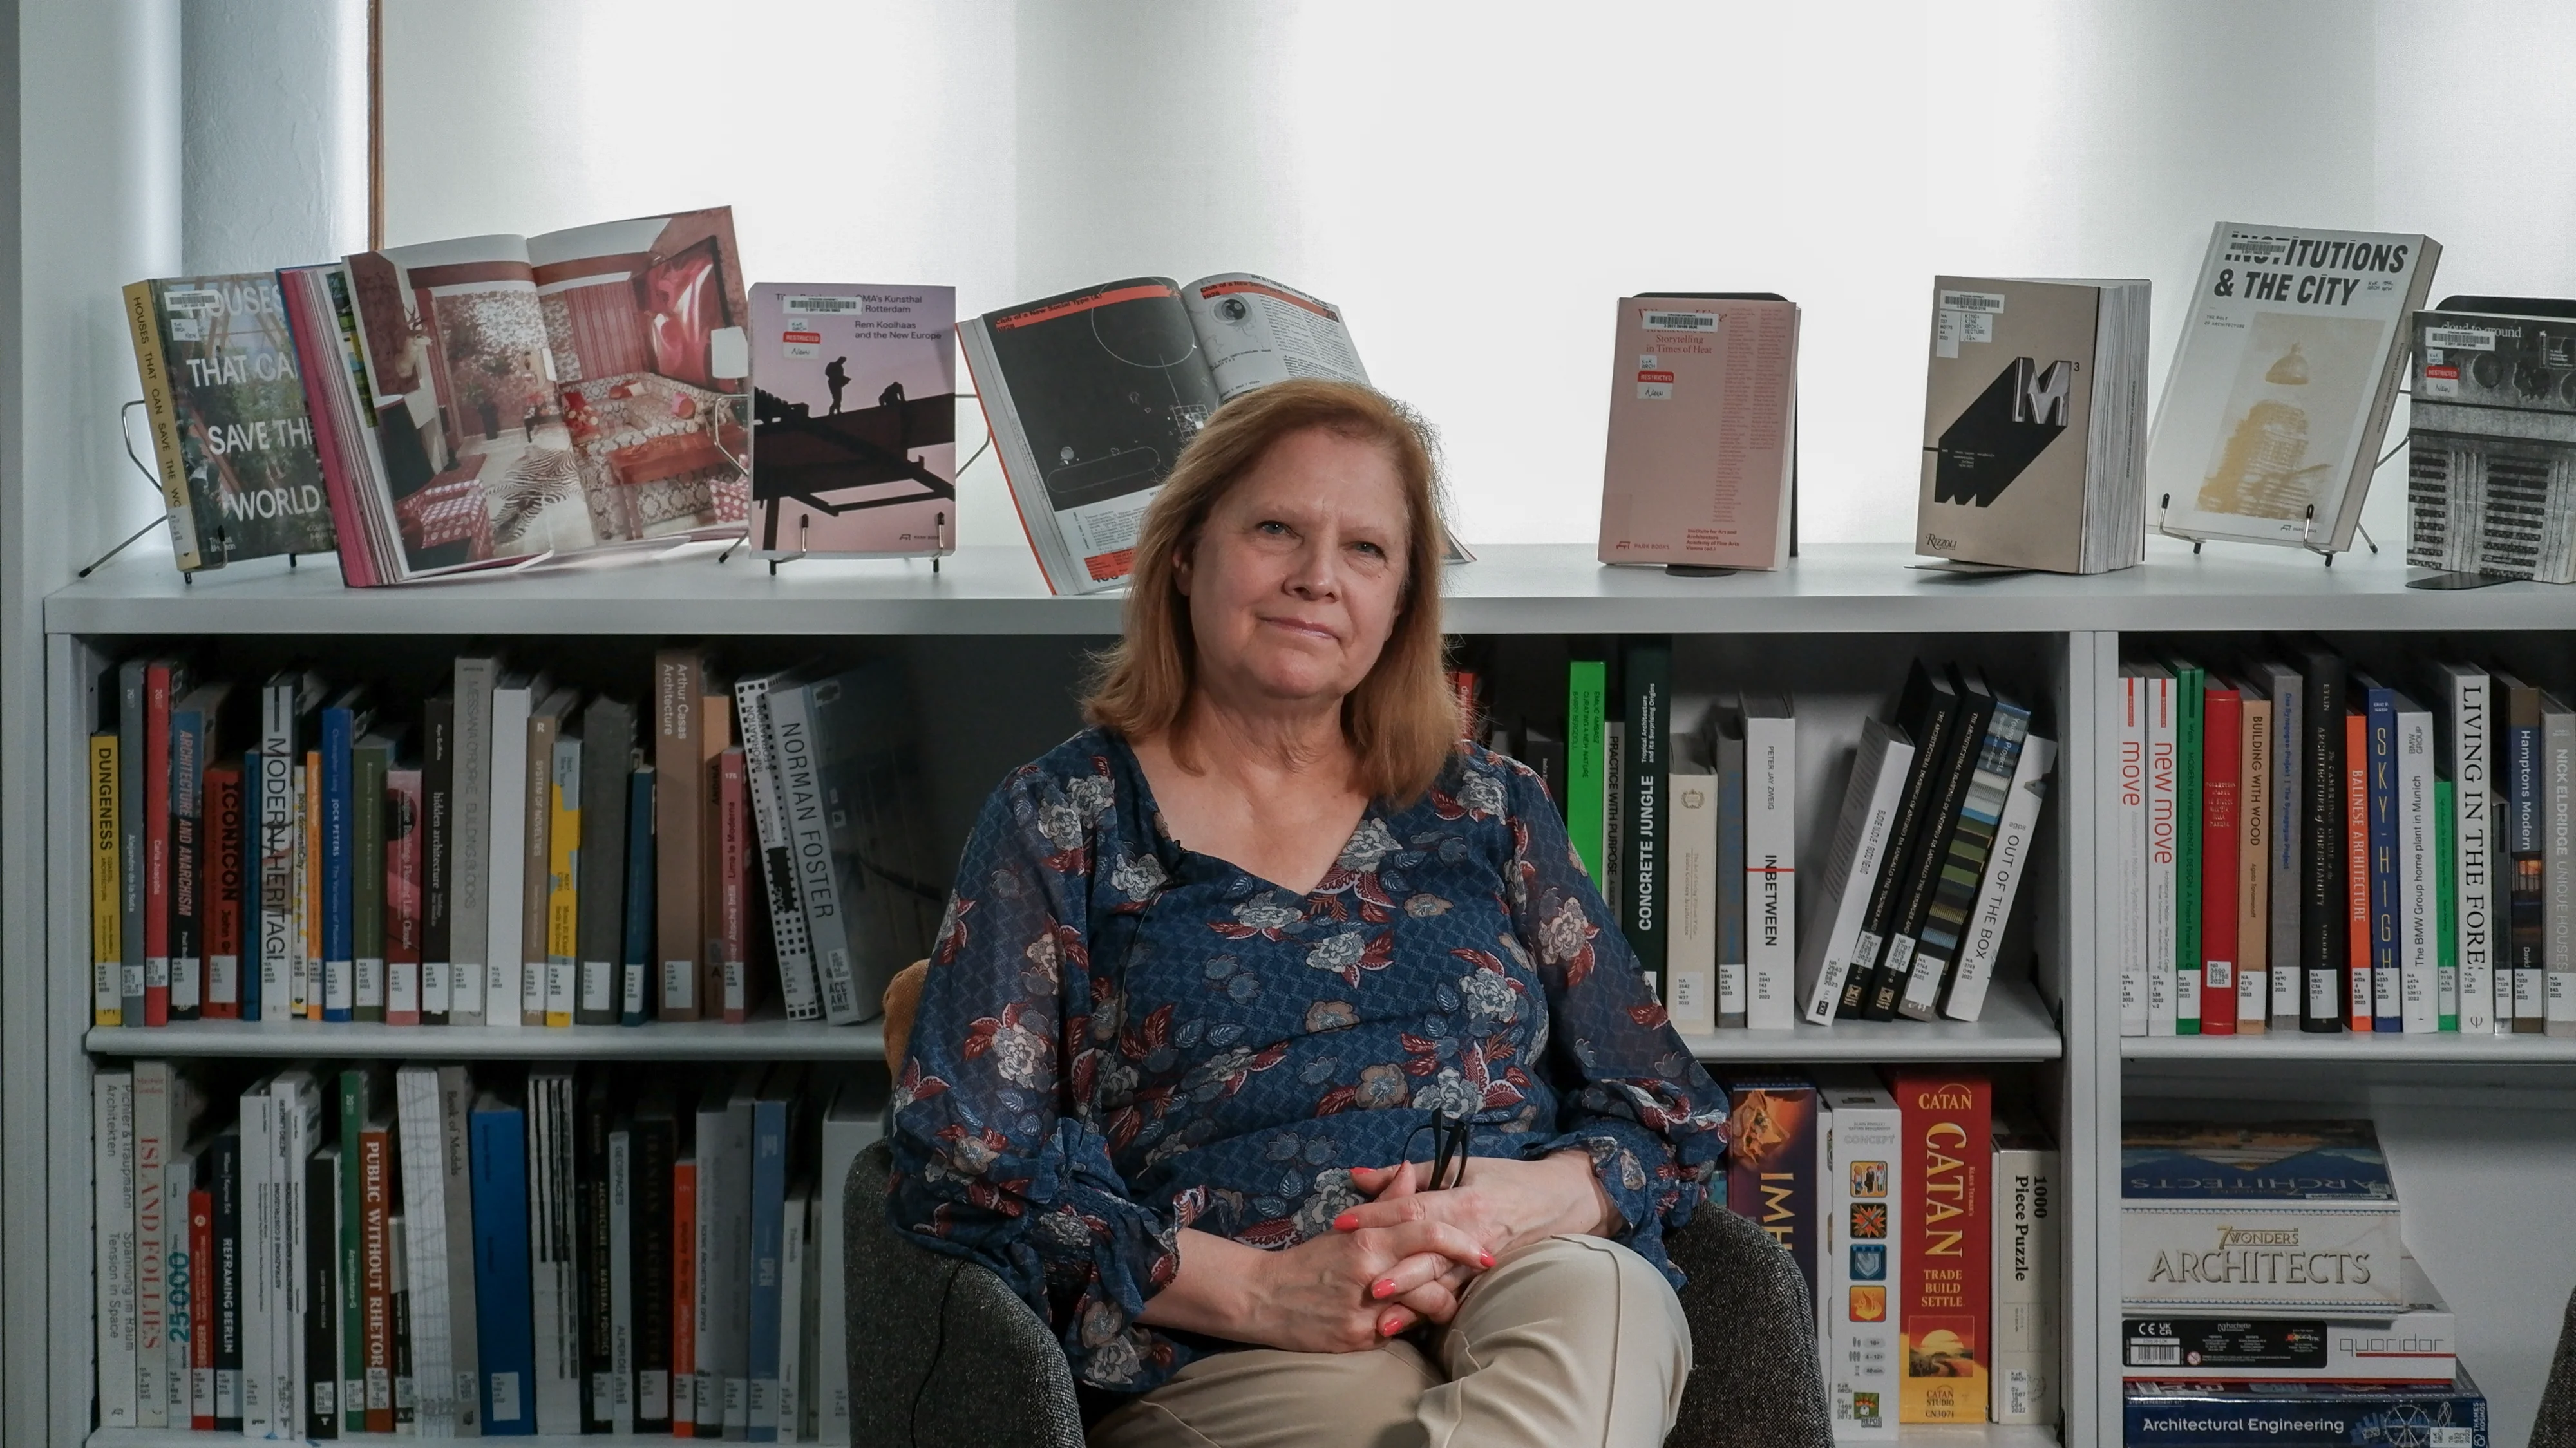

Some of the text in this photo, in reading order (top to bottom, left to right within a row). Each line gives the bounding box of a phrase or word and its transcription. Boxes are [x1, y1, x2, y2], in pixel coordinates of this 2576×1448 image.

[865, 305, 911, 314] Rotterdam
[884, 295, 922, 303] Kunsthal
[2214, 268, 2361, 306] & THE CITY
[877, 321, 916, 330] Koolhaas
[911, 333, 942, 341] Europe
[1646, 344, 1712, 353] in Times of Heat
[1656, 334, 1704, 344] Storytelling
[133, 297, 176, 480] HOUSES THAT CAN SAVE THE
[186, 352, 298, 387] THAT CA
[208, 417, 313, 455] SAVE TH
[229, 485, 321, 522] WORLD
[1926, 533, 1957, 550] RIZZOLI
[663, 664, 674, 735] Architecture
[677, 664, 688, 740] Arthur Casas
[746, 706, 763, 772] INFORMATION
[99, 748, 113, 851] DUNGENESS
[2123, 742, 2141, 805] move
[2154, 743, 2173, 864] new move
[2250, 716, 2263, 847] BUILDING WITH WOOD
[2519, 730, 2532, 851] Hamptons Modern
[178, 730, 193, 916] ARCHITECTURE AND ANARCHISM
[533, 760, 544, 856] SYSTEM NOVELTIES
[727, 802, 736, 843] Moderna
[781, 722, 835, 919] NORMAN FOSTER
[1607, 736, 1619, 876] PRACTICE WITH PURPOSE
[2009, 821, 2027, 831] agps
[2463, 686, 2486, 970] LIVING IN THE FORE
[127, 834, 136, 871] Alejandro
[222, 782, 239, 901] ICONICON
[432, 792, 444, 889] hidden architecture
[1638, 776, 1654, 931] CONCRETE JUNGLE
[2352, 770, 2366, 922] BALINESE ARCHITECTURE
[2412, 775, 2425, 968] The BMW Group home plant in Munich
[2556, 749, 2569, 971] NICK ELDRIDGE UNIQUE HOUSES
[1765, 855, 1777, 946] INBETWEEN
[1975, 834, 2020, 961] OUT OF THE BOX
[829, 981, 847, 993] ACC
[831, 993, 849, 1004] ART
[106, 1084, 118, 1158] Architekten
[1918, 1093, 1973, 1110] CATAN
[1844, 1134, 1895, 1145] CONCEPT
[615, 1146, 623, 1206] GEOSPACES
[1924, 1122, 1967, 1258] CATAN
[2034, 1176, 2047, 1219] 1000
[140, 1136, 160, 1349] ISLAND FOLLIES
[366, 1141, 384, 1367] PUBLIC WITHOUT RHETOR
[2015, 1175, 2029, 1282] Piece Puzzle
[2216, 1225, 2299, 1249] 7 WONDERS
[108, 1233, 122, 1339] Tension in Space
[223, 1238, 233, 1353] REFRAMING BERLIN
[1924, 1270, 1962, 1281] TRADE
[1925, 1283, 1961, 1294] BUILD
[2148, 1248, 2371, 1285] ARCHITECTS
[1921, 1297, 1964, 1308] SETTLE
[2339, 1335, 2445, 1358] quoridor
[1926, 1389, 1954, 1399] CATAN
[2143, 1418, 2345, 1434] Architectural Engineering
